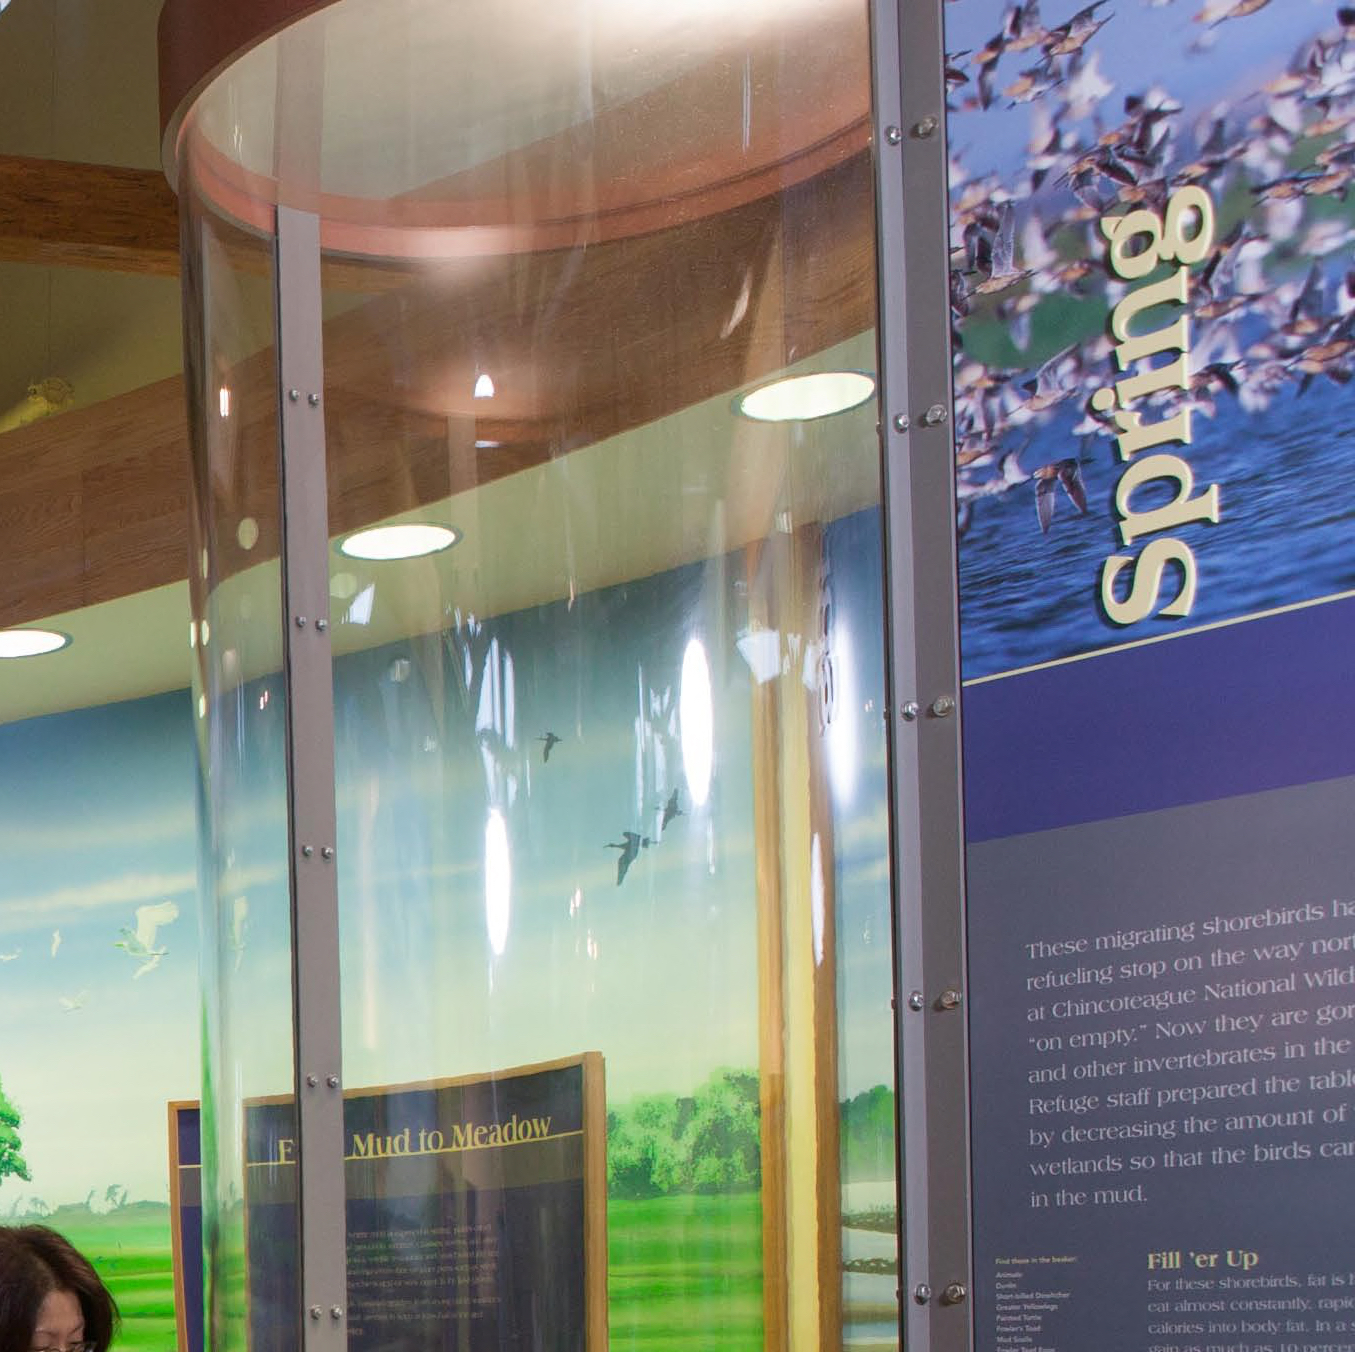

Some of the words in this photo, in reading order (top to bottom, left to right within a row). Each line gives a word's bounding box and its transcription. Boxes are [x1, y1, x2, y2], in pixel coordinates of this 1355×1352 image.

[1090, 186, 1220, 626] Spring
[1025, 940, 1088, 960] These
[1095, 924, 1195, 952] migrating
[1202, 903, 1324, 936] shorebirds
[1026, 967, 1113, 990] refueling
[1119, 959, 1166, 980] stop
[1174, 956, 1202, 972] on
[1210, 947, 1244, 967] the
[1252, 943, 1304, 963] way
[1027, 1003, 1044, 1021] at
[1052, 990, 1196, 1018] Chincoteague
[1203, 972, 1296, 1001] National
[1155, 1020, 1207, 1039] Now
[1214, 1013, 1263, 1035] they
[1270, 1011, 1308, 1027] are
[1028, 1062, 1065, 1082] and
[1073, 1058, 1126, 1078] other
[1133, 1045, 1275, 1073] invertebrates
[1284, 1042, 1305, 1059] in
[1313, 1036, 1351, 1056] the
[1029, 1094, 1099, 1114] Refuge
[1106, 1086, 1152, 1107] staff
[1157, 1076, 1257, 1107] prepared
[1264, 1074, 1300, 1093] the
[353, 1128, 410, 1157] Mud
[419, 1128, 444, 1152] to
[452, 1114, 551, 1150] Meadow
[1029, 1127, 1054, 1148] by
[1061, 1120, 1176, 1141] decreasing
[1183, 1114, 1217, 1133] the
[1224, 1106, 1314, 1130] amount
[1322, 1103, 1347, 1123] of
[1030, 1153, 1122, 1175] wetlands
[1129, 1156, 1155, 1169] so
[1162, 1147, 1204, 1167] that
[1211, 1145, 1245, 1164] the
[1253, 1141, 1311, 1161] birds
[1030, 1192, 1048, 1207] in
[1055, 1189, 1086, 1206] the
[1093, 1185, 1147, 1204] mud.
[1148, 1251, 1181, 1269] Fill
[1226, 1249, 1259, 1270] Up
[1147, 1279, 1171, 1290] For
[1174, 1278, 1214, 1290] these
[1307, 1273, 1326, 1286] fat
[1147, 1300, 1169, 1312] eat
[1174, 1299, 1225, 1312] almost
[1147, 1322, 1204, 1334] calories
[1241, 1320, 1279, 1335] body
[1253, 1345, 1273, 1352] as
[1279, 1341, 1298, 1352] 10
